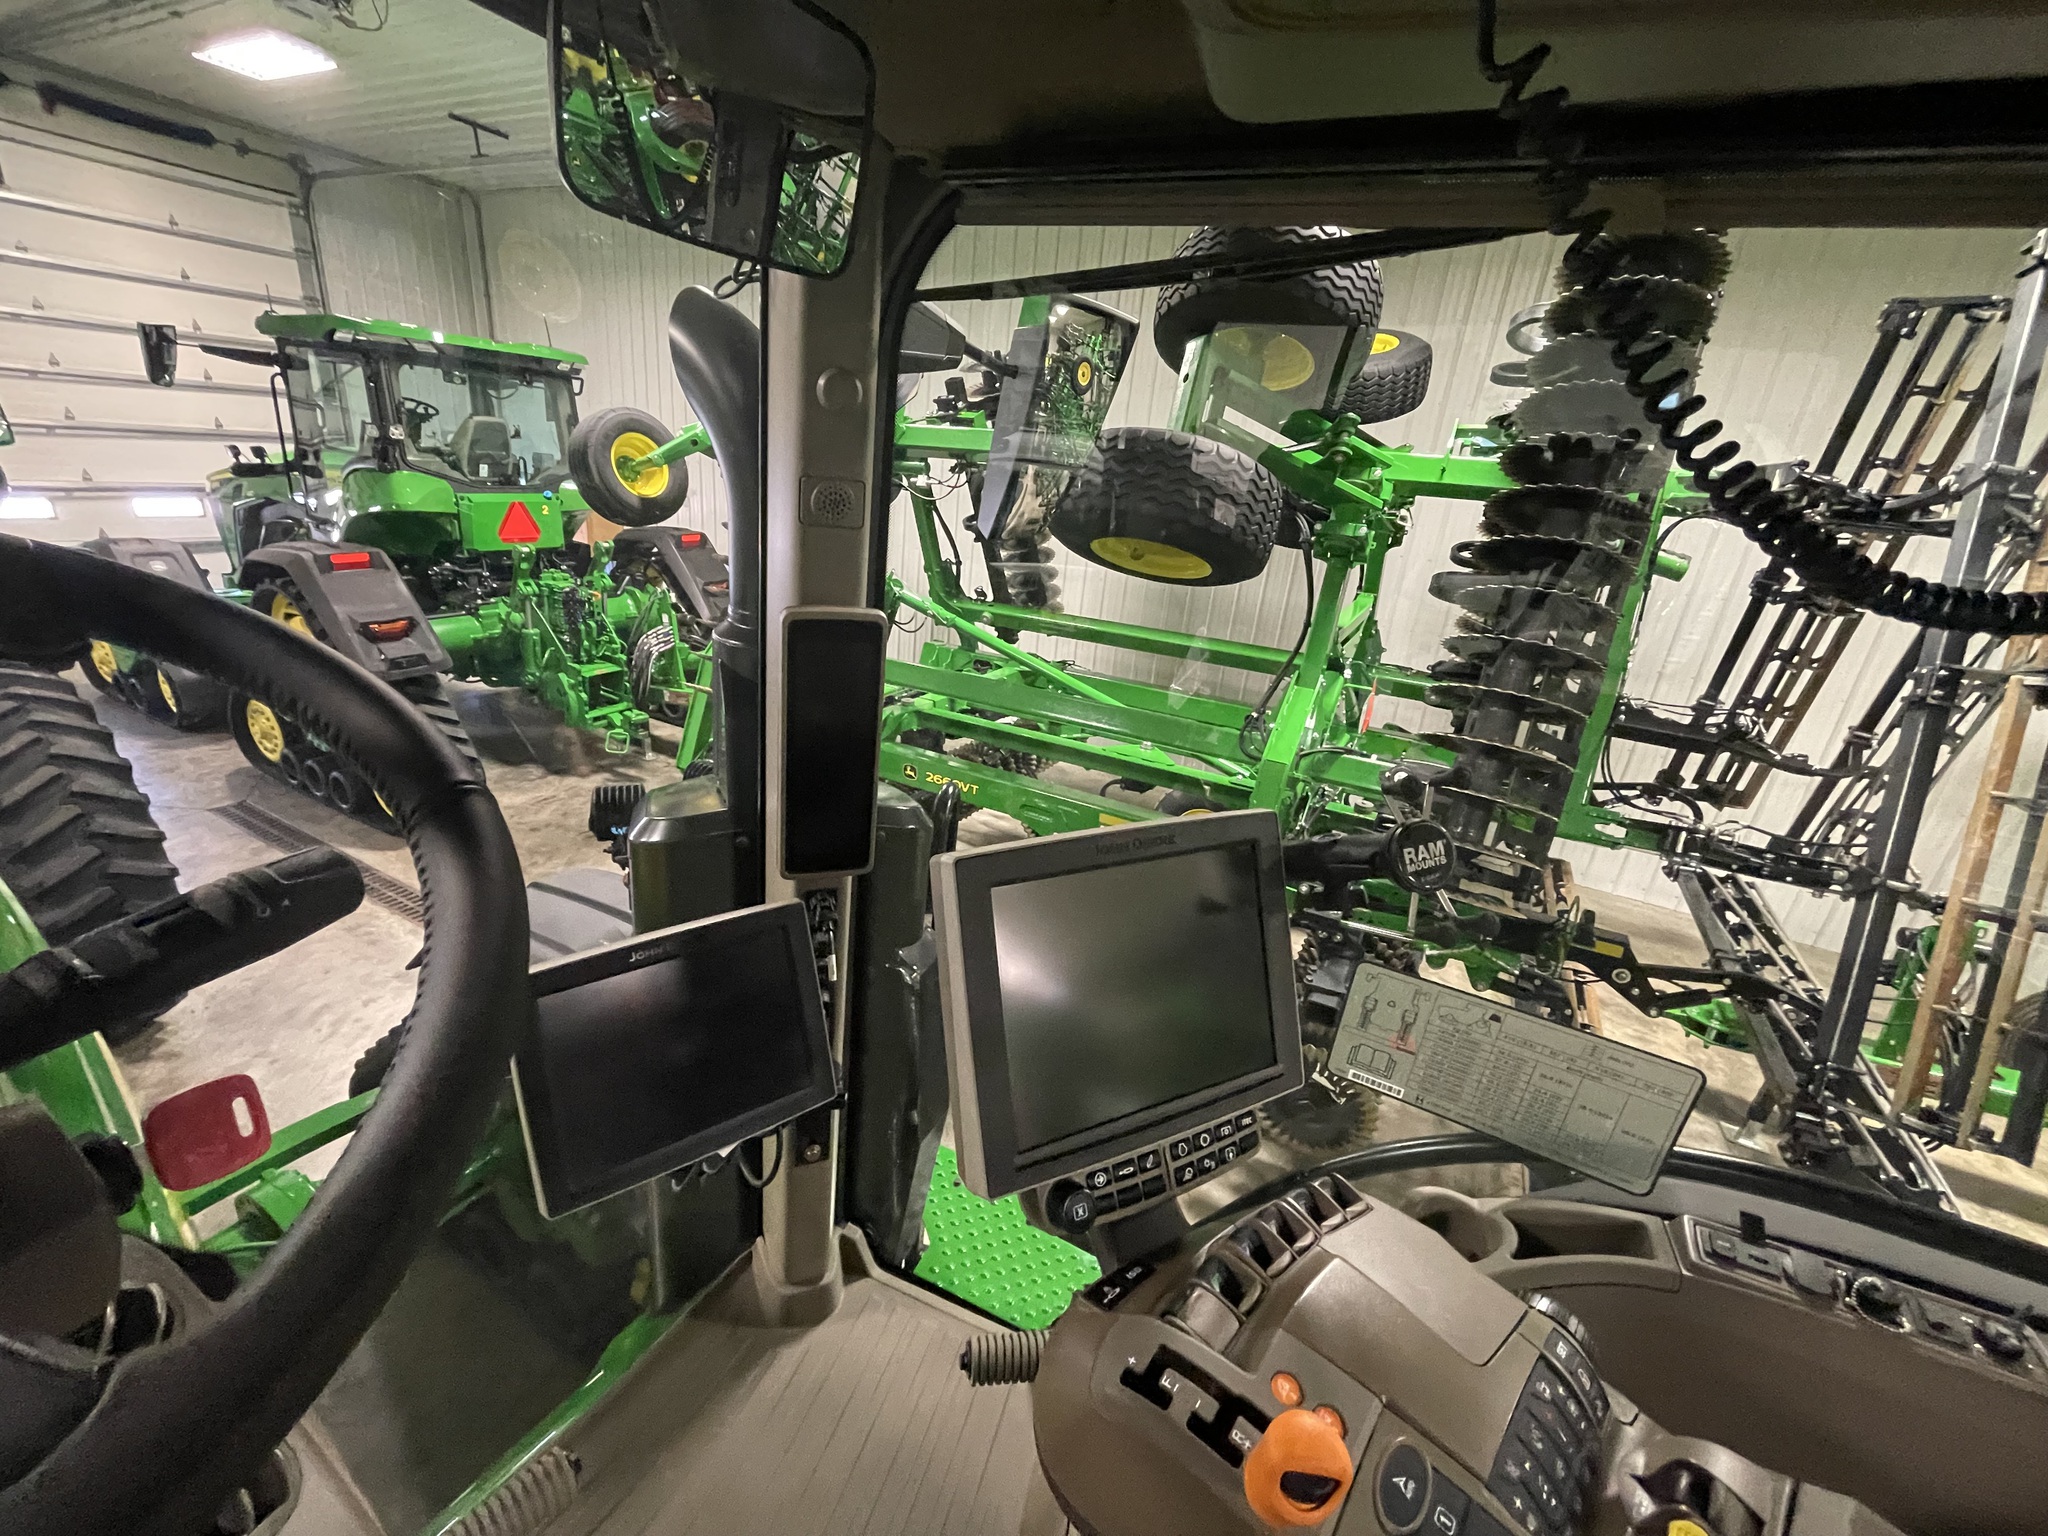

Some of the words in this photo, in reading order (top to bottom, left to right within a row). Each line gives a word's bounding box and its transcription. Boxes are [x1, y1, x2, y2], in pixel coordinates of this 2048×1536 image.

[542, 504, 549, 515] 2
[1403, 840, 1445, 864] RAM
[1406, 855, 1448, 873] MOUNTS
[1161, 1375, 1172, 1389] F
